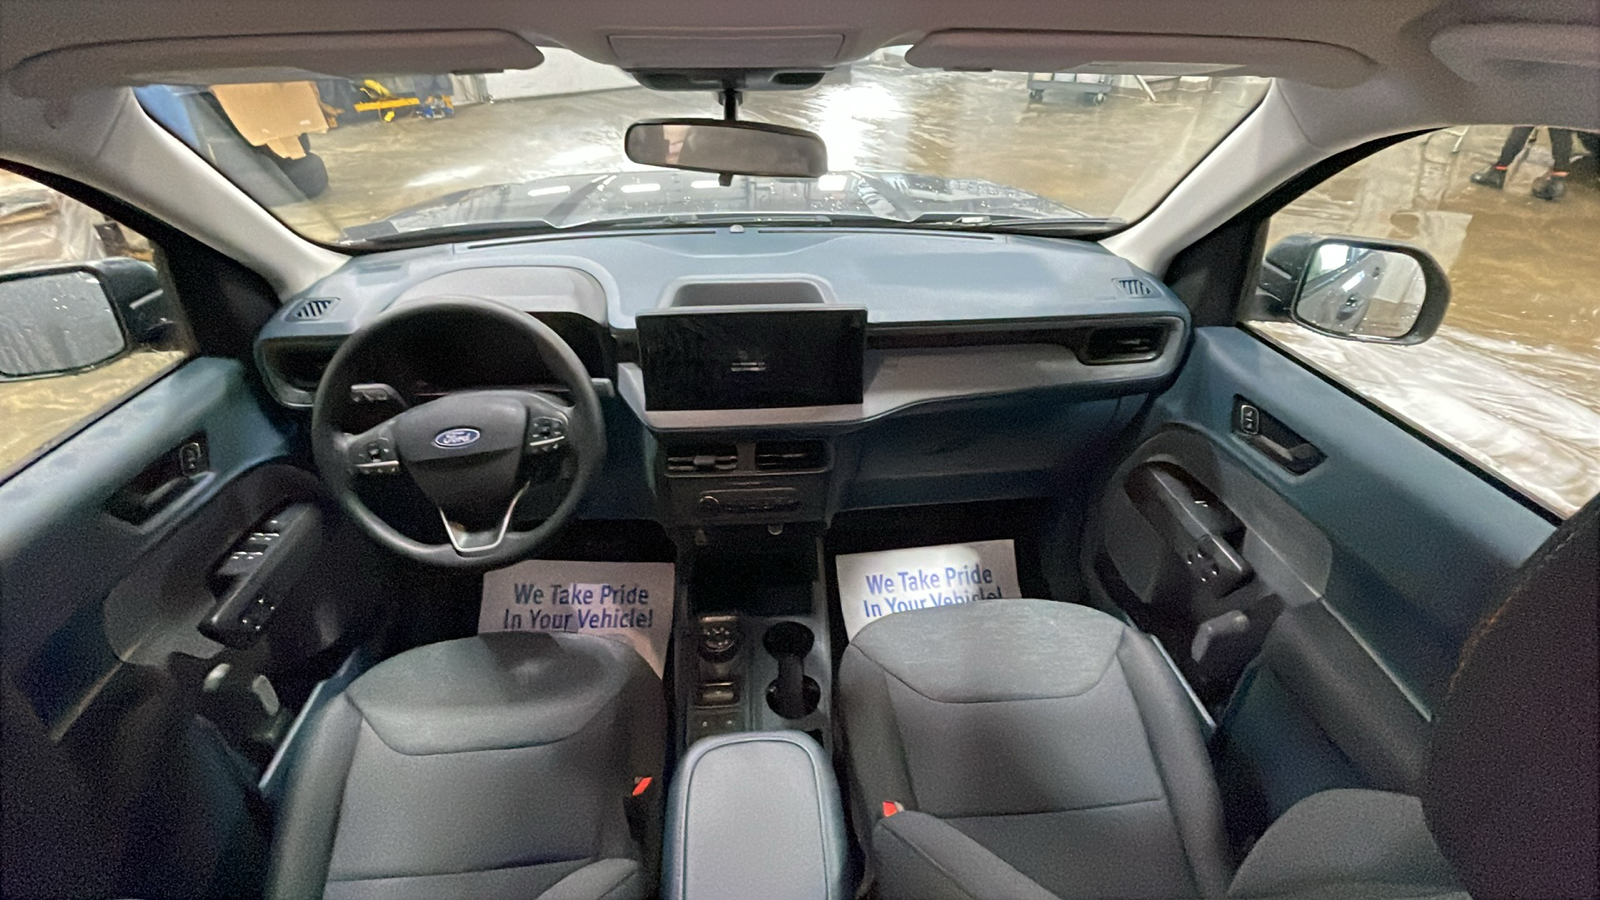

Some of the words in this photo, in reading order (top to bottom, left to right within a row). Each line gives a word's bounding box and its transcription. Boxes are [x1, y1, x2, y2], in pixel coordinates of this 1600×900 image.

[442, 431, 471, 444] Ford
[865, 574, 895, 595] We
[897, 569, 941, 592] Take
[945, 564, 993, 585] Pride
[514, 583, 544, 605] We
[551, 584, 594, 605] Take
[600, 584, 649, 605] Pride
[863, 600, 882, 618] In
[885, 597, 926, 613] Your
[503, 609, 522, 629] In
[529, 610, 573, 630] Your
[576, 609, 653, 628] Vehicle!
